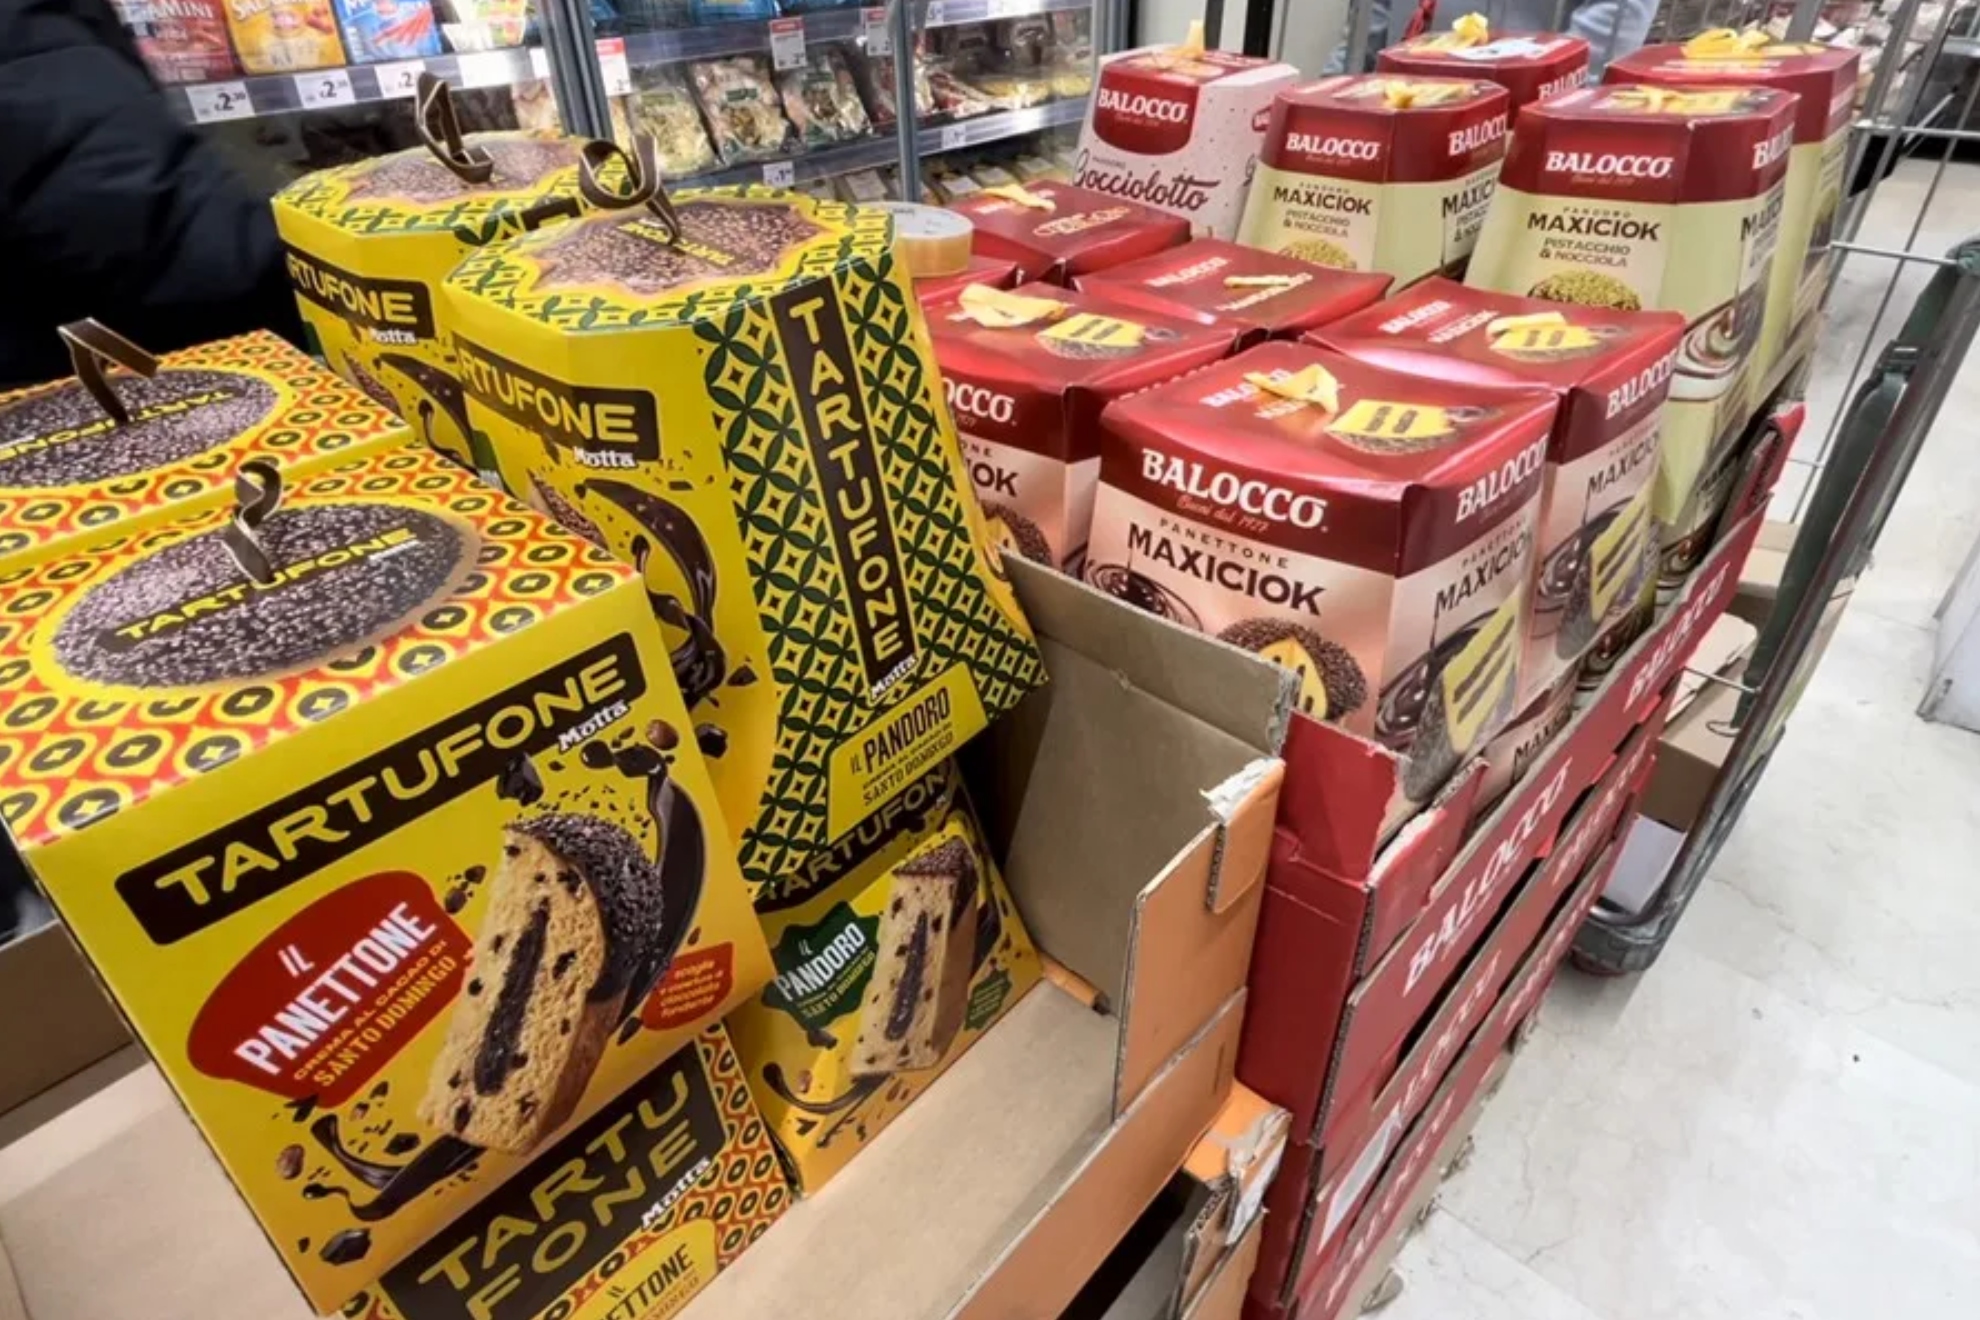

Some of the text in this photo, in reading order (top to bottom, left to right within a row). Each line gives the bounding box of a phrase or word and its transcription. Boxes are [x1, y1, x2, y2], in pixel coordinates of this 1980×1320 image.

[1098, 88, 1188, 123] BALOCCO
[1286, 132, 1381, 160] BALOCCO
[1545, 151, 1674, 178] BALOCCO
[1273, 186, 1373, 216] MAXICIOK
[1527, 212, 1661, 241] MAXICIOK
[1539, 248, 1550, 258] &
[1544, 237, 1631, 255] PISTACCHIO
[573, 445, 638, 468] Motta
[789, 296, 904, 662] TARTUFONE
[1142, 448, 1329, 529] BALOCCO
[1127, 522, 1326, 616] MAXICIOK
[1159, 517, 1289, 570] PANETTONE
[557, 699, 630, 751] Motta
[863, 686, 951, 774] PANDORO
[154, 653, 627, 905] TARTUFONE
[1402, 756, 1574, 998] BALOCCO
[233, 901, 438, 1076] PANETTONE
[277, 944, 315, 978] IL
[774, 921, 867, 1002] PANDORO
[293, 1028, 354, 1081] CREMA
[354, 1008, 376, 1029] AL
[375, 955, 430, 1008] CACAO
[313, 955, 458, 1087] SANTO DOMINGO
[417, 1070, 690, 1290] TARTU
[640, 1156, 713, 1230] Motta
[465, 1119, 698, 1320] FONE
